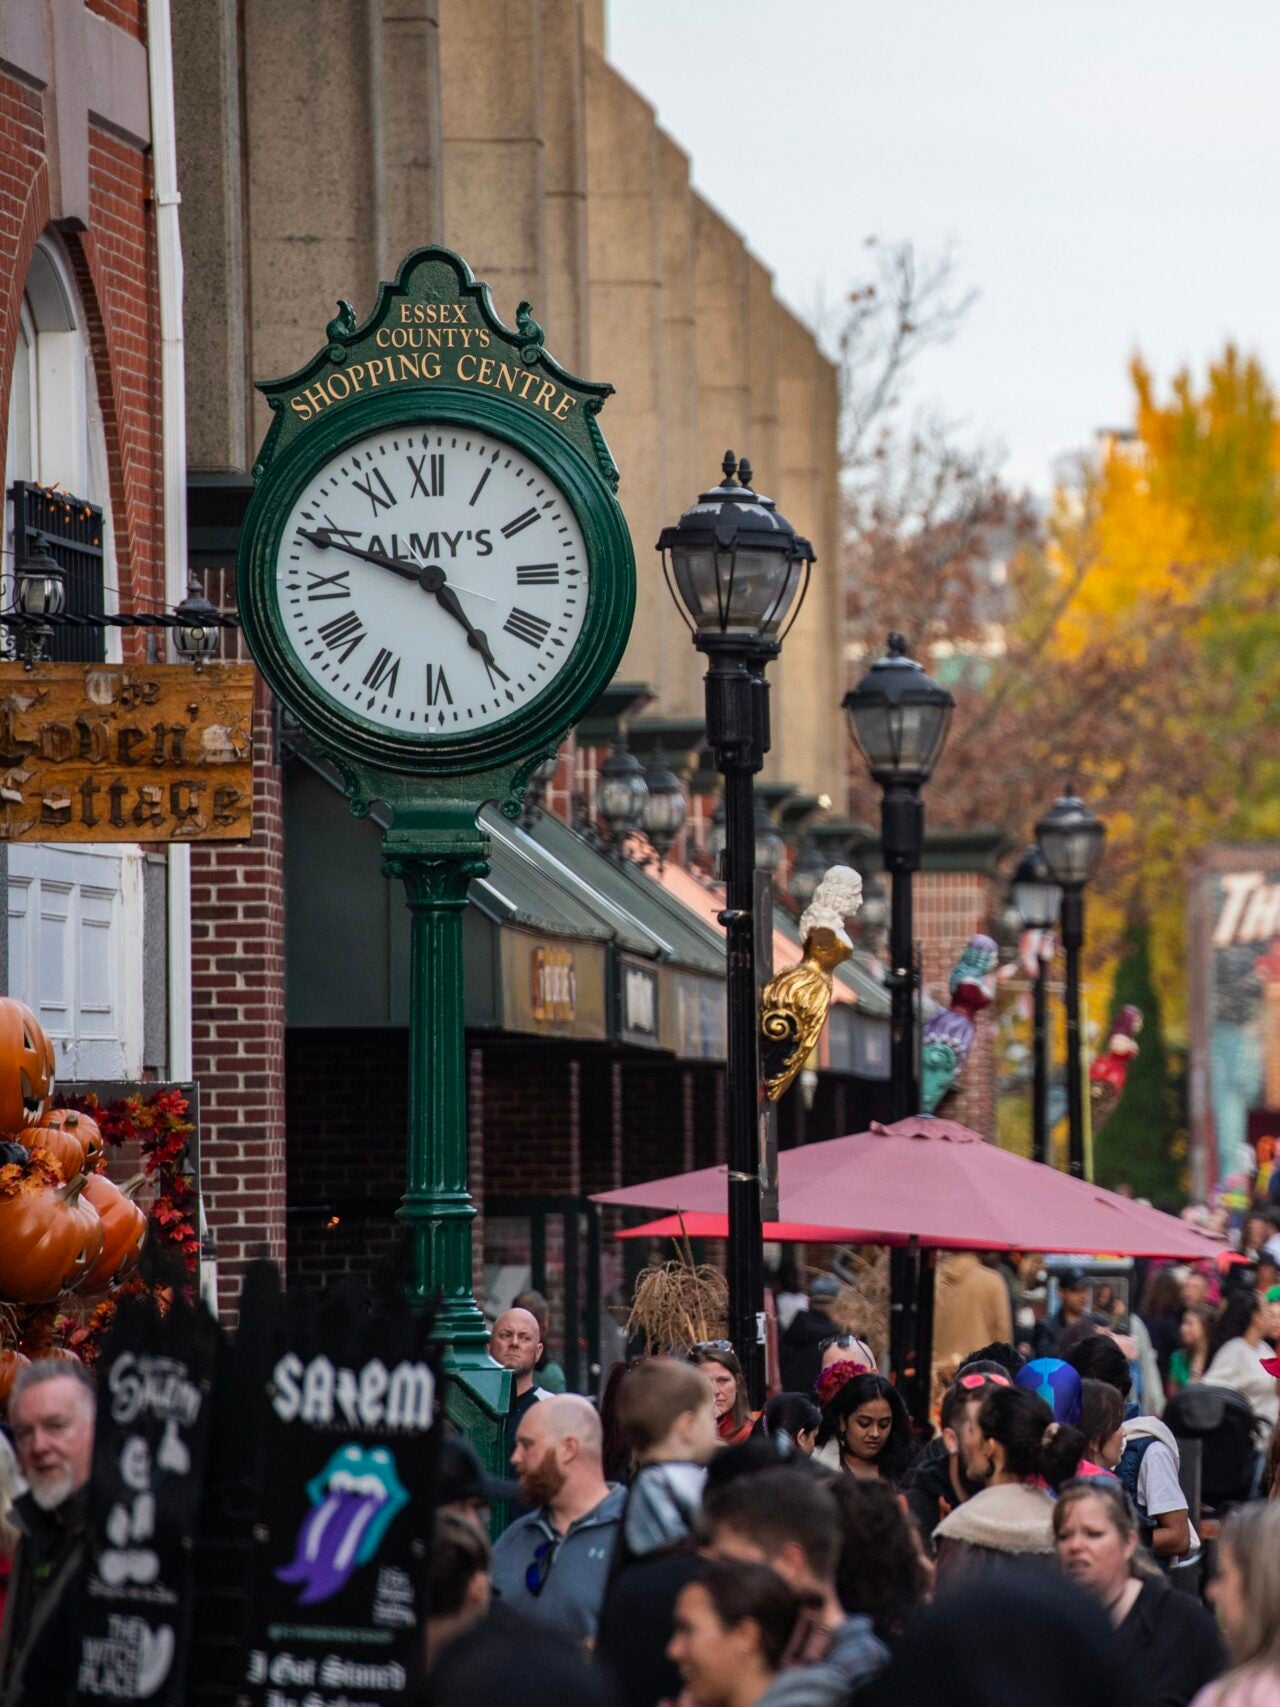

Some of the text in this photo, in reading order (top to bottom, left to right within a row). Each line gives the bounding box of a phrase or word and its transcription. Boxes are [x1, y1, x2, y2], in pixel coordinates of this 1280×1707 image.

[400, 304, 468, 324] ESSEX
[375, 327, 491, 348] COUNTY'S
[290, 352, 577, 421] SHOPPING CENTRE
[352, 467, 398, 517] XI
[406, 454, 444, 499] XII
[468, 467, 492, 506] I
[500, 506, 542, 539] II
[366, 528, 494, 560] ALMY'S
[307, 570, 351, 601] IX
[516, 563, 560, 585] III
[317, 610, 368, 665] VIII
[502, 606, 552, 650] IIII
[362, 647, 401, 698] VII
[426, 663, 454, 706] VI
